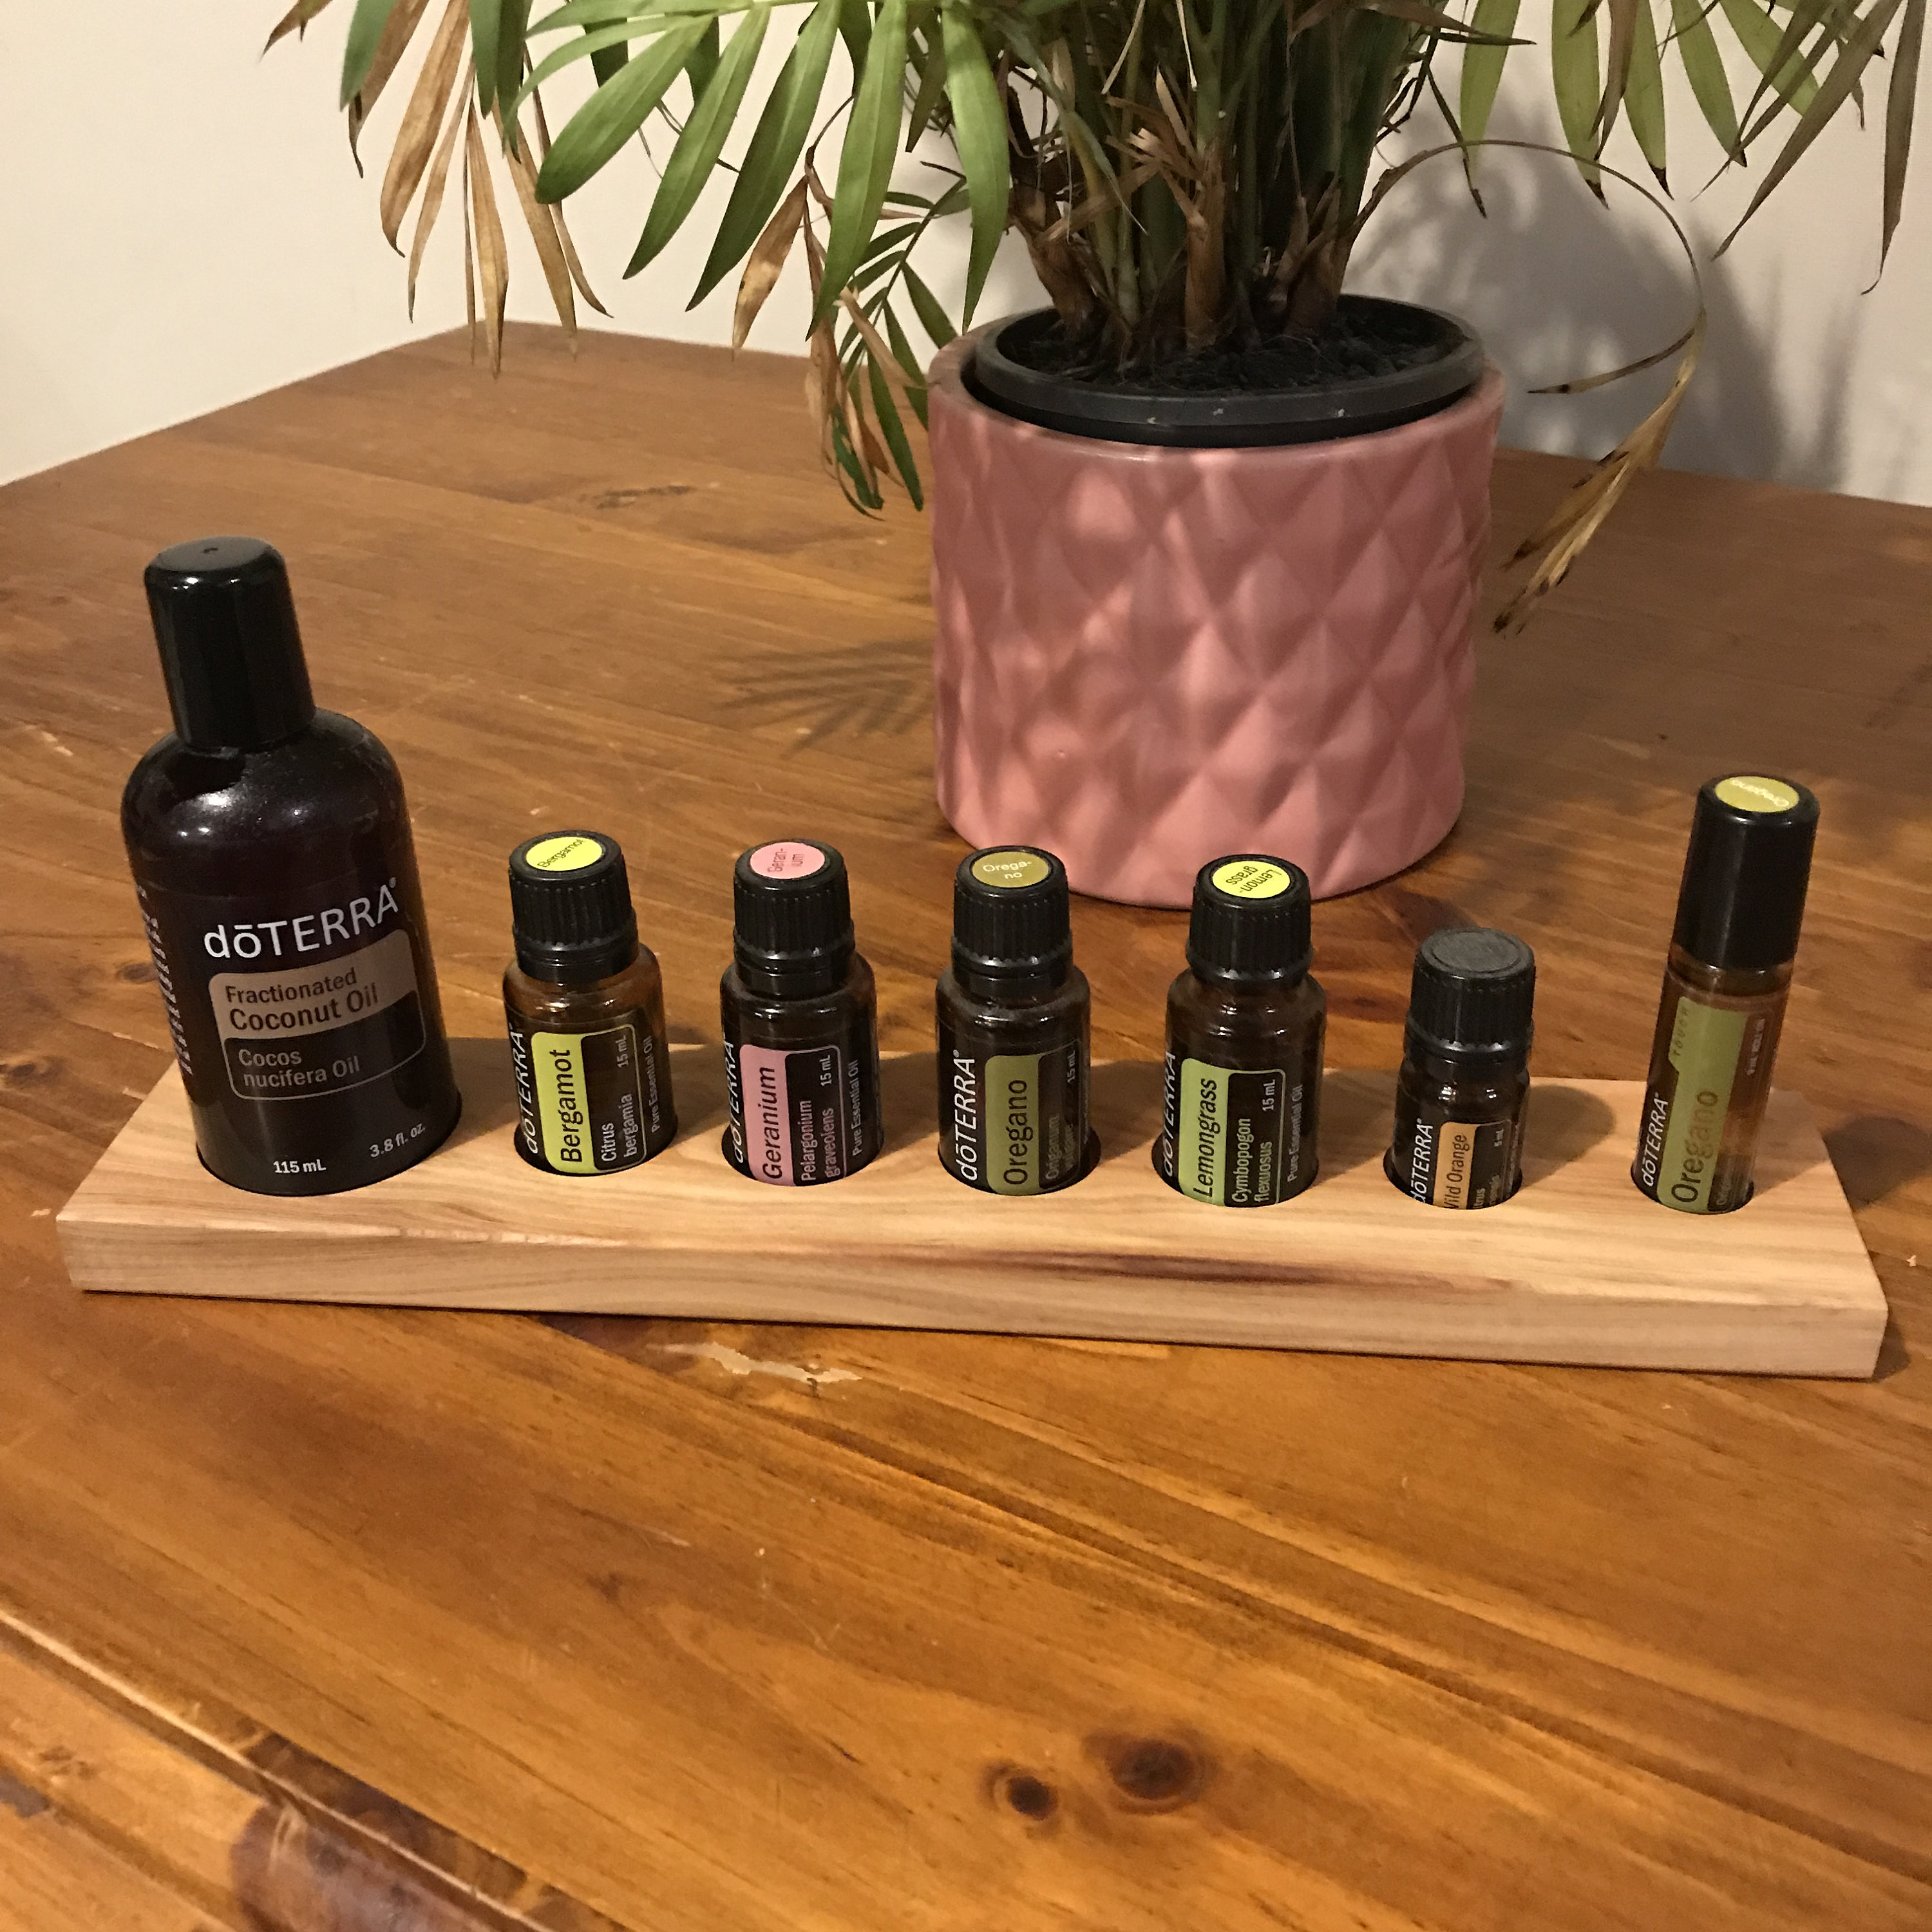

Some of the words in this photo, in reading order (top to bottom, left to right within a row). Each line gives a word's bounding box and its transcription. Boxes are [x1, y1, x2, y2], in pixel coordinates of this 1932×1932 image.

[536, 839, 586, 868] Bergamot
[983, 860, 1032, 872] Orega-
[1226, 866, 1258, 885] grass
[1239, 869, 1282, 893] Lemon-
[225, 967, 357, 1004] Fractionated
[229, 999, 342, 1031] Coconut
[346, 983, 379, 1012] Oil
[238, 1048, 302, 1067] Cocos
[615, 1034, 629, 1053] mL
[643, 1035, 653, 1054] Oil
[243, 1066, 327, 1088] nucifera
[332, 1055, 360, 1079] Oil
[617, 1054, 629, 1069] 15
[819, 1054, 831, 1072] mL
[847, 1059, 859, 1079] Oil
[1066, 1069, 1075, 1084] 15
[645, 1054, 658, 1106] Essential
[820, 1073, 833, 1087] 15
[1263, 1079, 1276, 1096] mL
[549, 1049, 583, 1162] Bergamot
[650, 1104, 661, 1133] Pure
[848, 1080, 862, 1132] Essential
[953, 1058, 978, 1181] dōTERRA
[1262, 1097, 1274, 1112] 15
[618, 1093, 639, 1159] bergamia
[758, 1066, 783, 1180] Geranium
[1003, 1079, 1034, 1186] Oregano
[1193, 1078, 1221, 1198] Lemongrass
[1289, 1103, 1302, 1155] Essential
[368, 1139, 393, 1158] 3.8
[395, 1132, 409, 1147] fl.
[601, 1122, 617, 1162] Citrus
[797, 1099, 818, 1182] Pelargonium
[820, 1107, 841, 1179] graveolens
[852, 1132, 863, 1157] Pure
[1671, 1090, 1719, 1203] Oregano
[273, 1160, 300, 1174] 115
[303, 1159, 327, 1173] mL
[1231, 1117, 1255, 1203] Cymbopogon
[1254, 1141, 1273, 1203] flexuosus
[1287, 1155, 1300, 1182] Pure
[1446, 1134, 1470, 1181] Orange
